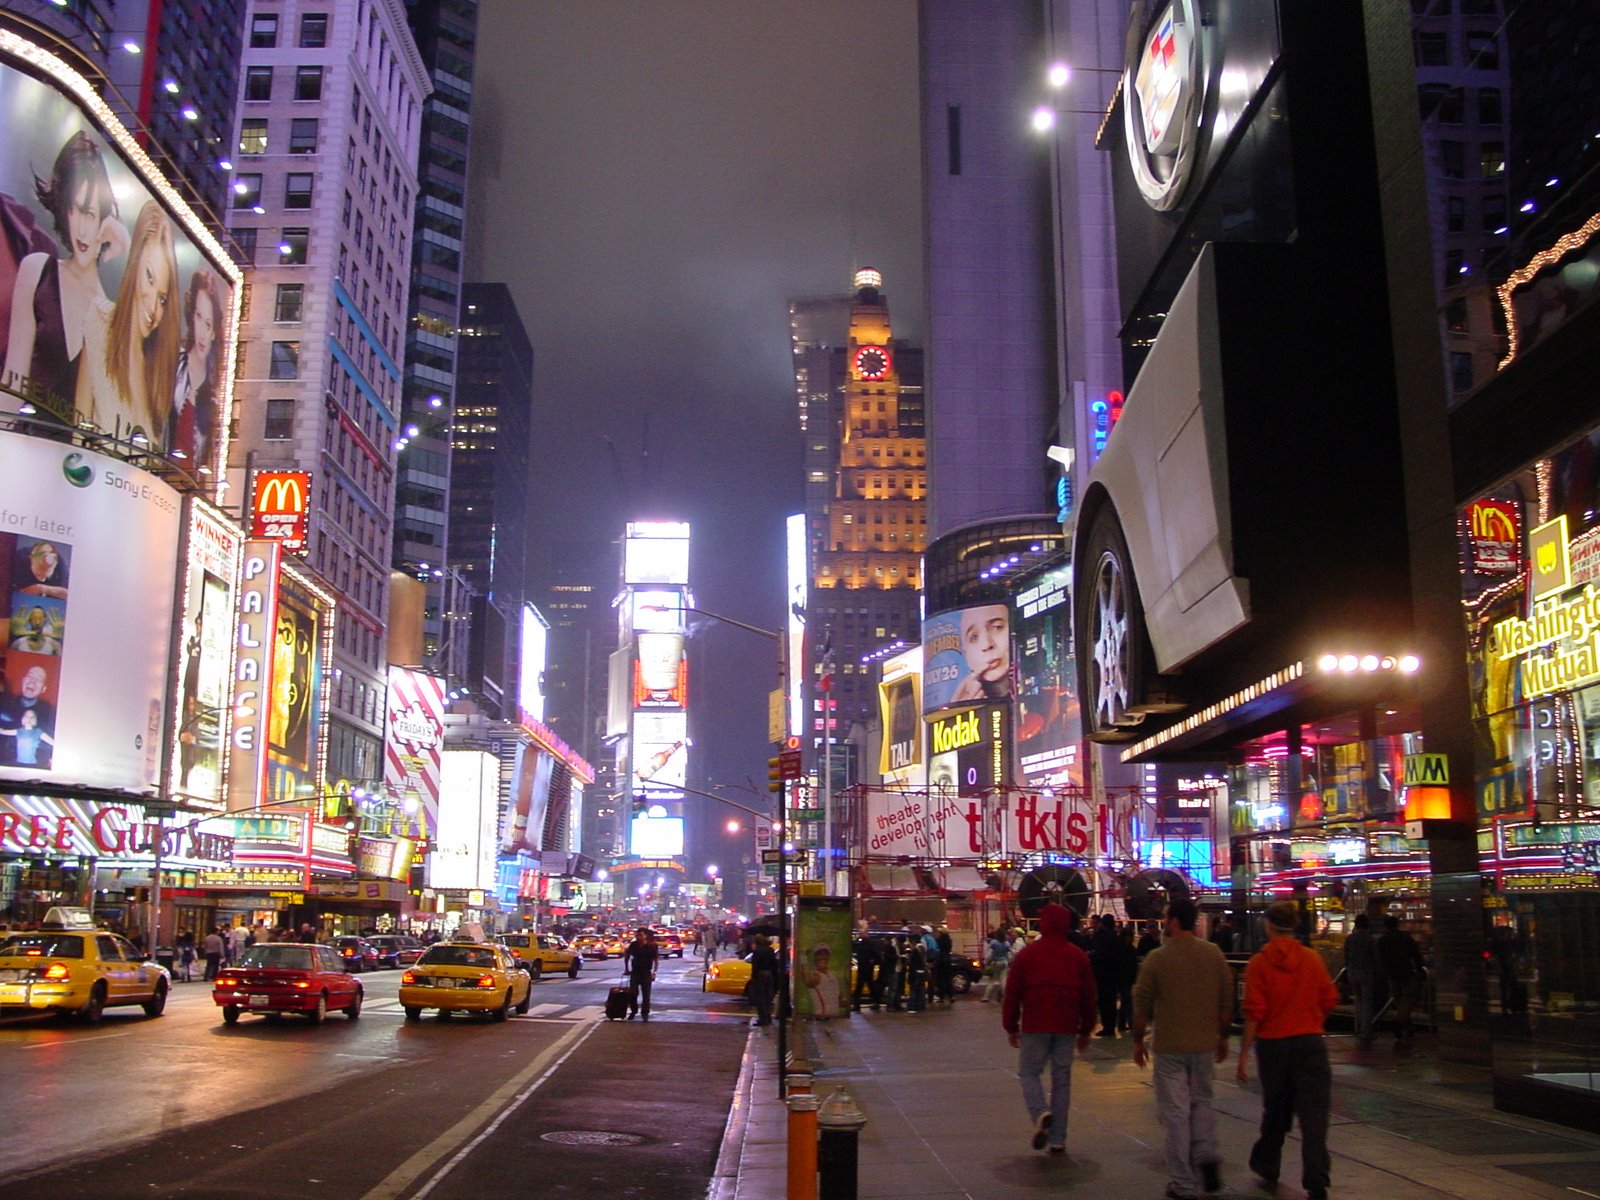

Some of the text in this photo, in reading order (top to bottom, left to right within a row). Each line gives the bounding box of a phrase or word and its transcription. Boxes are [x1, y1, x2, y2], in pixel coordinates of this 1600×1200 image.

[105, 472, 140, 498] Sony
[2, 510, 75, 538] for later.
[261, 515, 299, 523] OPEN
[264, 524, 293, 537] 24
[235, 557, 265, 749] PALACE
[1521, 630, 1600, 699] Mutual
[942, 665, 959, 681] 26
[400, 721, 432, 738] FRIDAY'S
[933, 711, 980, 753] Kodak
[992, 711, 1001, 739] Share
[871, 803, 957, 850] development
[876, 803, 921, 830] theatre
[0, 812, 75, 850] REE
